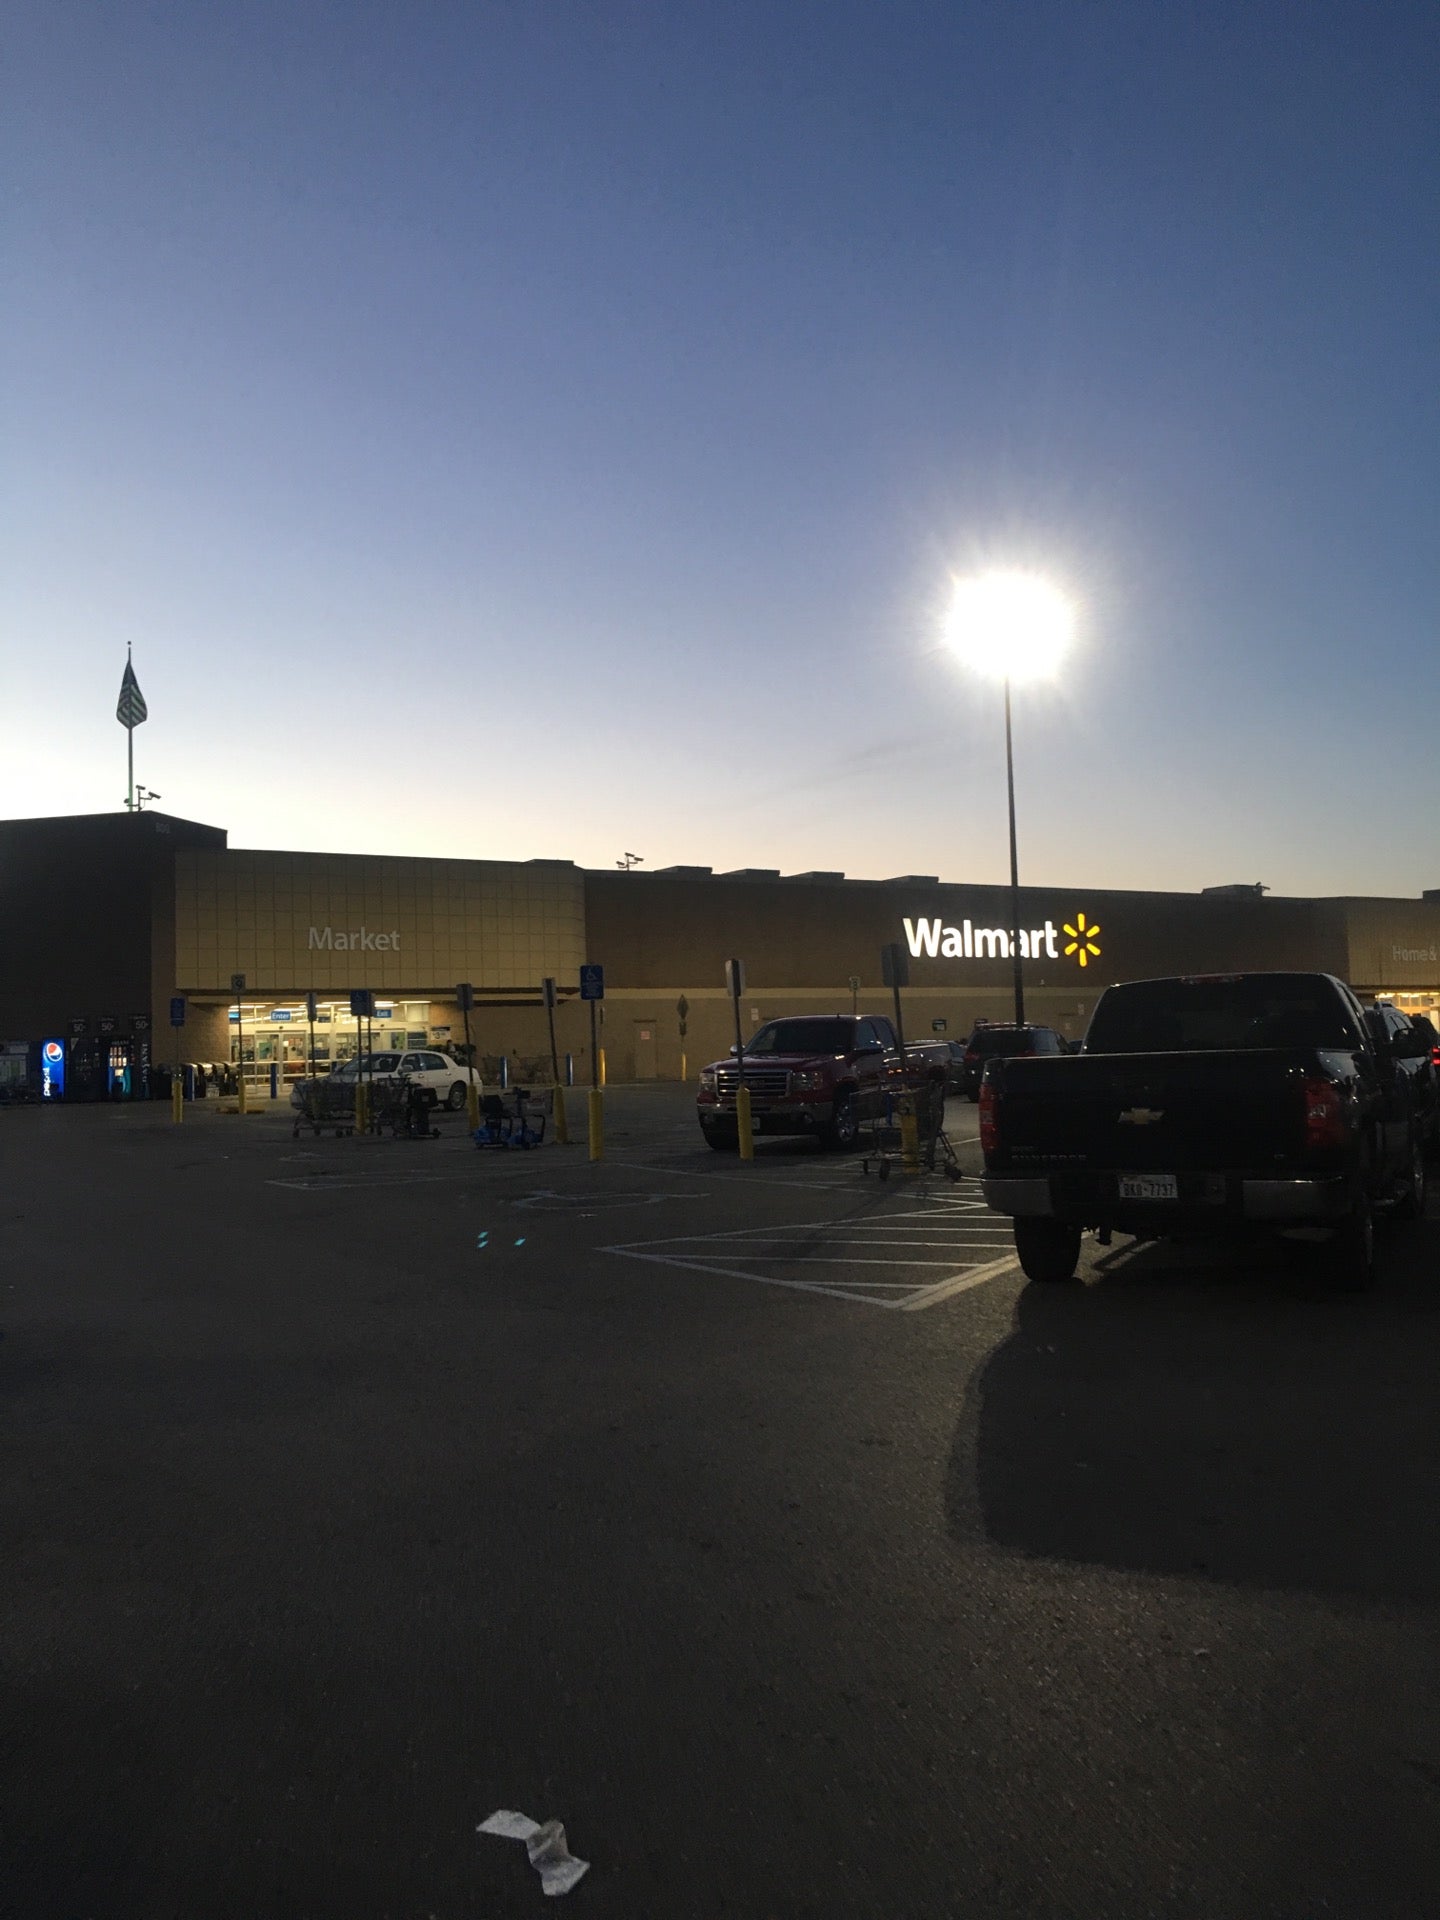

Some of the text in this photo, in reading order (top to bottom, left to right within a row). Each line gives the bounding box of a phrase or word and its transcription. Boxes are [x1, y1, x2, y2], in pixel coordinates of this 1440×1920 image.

[308, 926, 401, 951] Market
[902, 917, 1059, 959] Walmart
[272, 1012, 290, 1020] Enter
